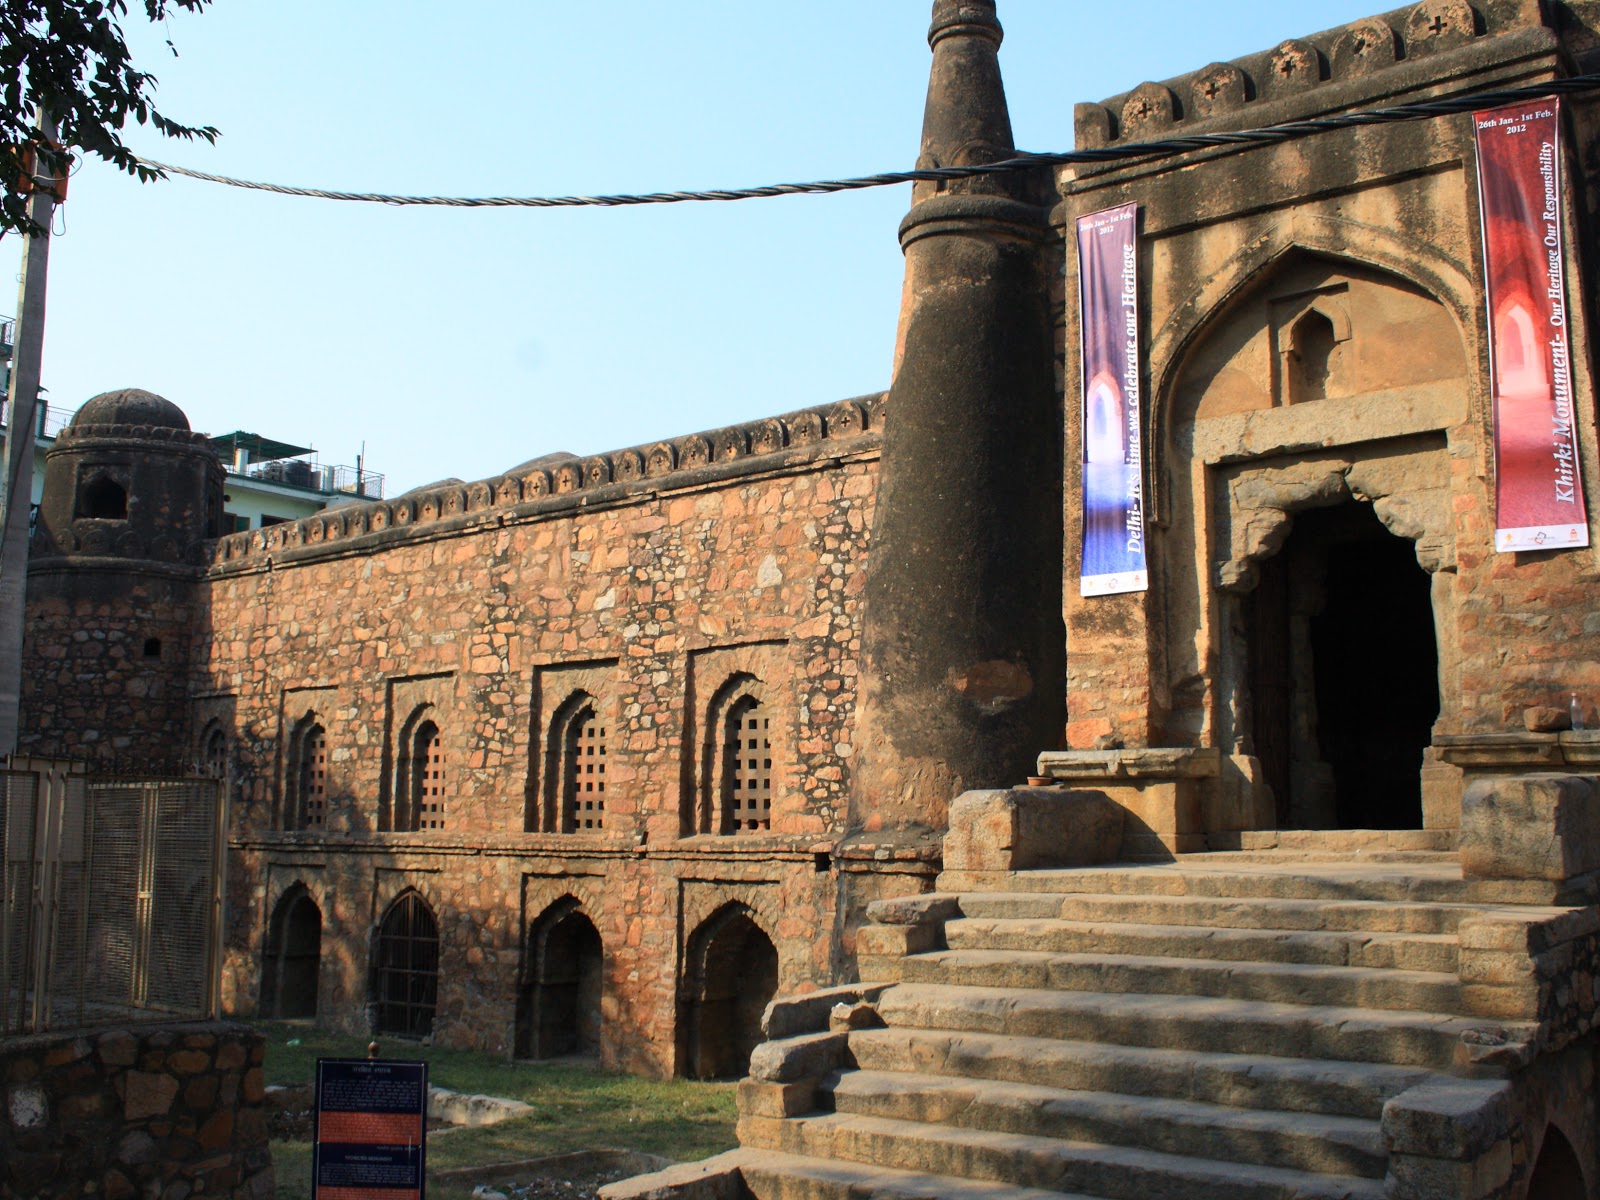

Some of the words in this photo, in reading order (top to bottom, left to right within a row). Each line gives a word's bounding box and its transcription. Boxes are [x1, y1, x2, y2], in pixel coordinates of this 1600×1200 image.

[1479, 120, 1496, 129] 26th
[1498, 117, 1513, 126] Jan
[1521, 113, 1533, 122] 1st
[1535, 109, 1553, 119] Feb.
[1506, 124, 1527, 134] 2012
[1539, 142, 1555, 221] Responsibility
[1094, 220, 1105, 228] Jan
[1110, 215, 1119, 223] 1st
[1099, 225, 1114, 235] 2012
[1543, 223, 1557, 247] Our
[1121, 244, 1134, 306] Heritage
[1547, 249, 1561, 299] Heritage
[1125, 311, 1136, 337] our
[1550, 302, 1564, 327] Our
[1124, 340, 1138, 407] celebrate
[1128, 411, 1138, 434] we
[1126, 435, 1140, 471] time
[1552, 442, 1574, 505] Khirki
[1126, 504, 1141, 554] Delhi-
